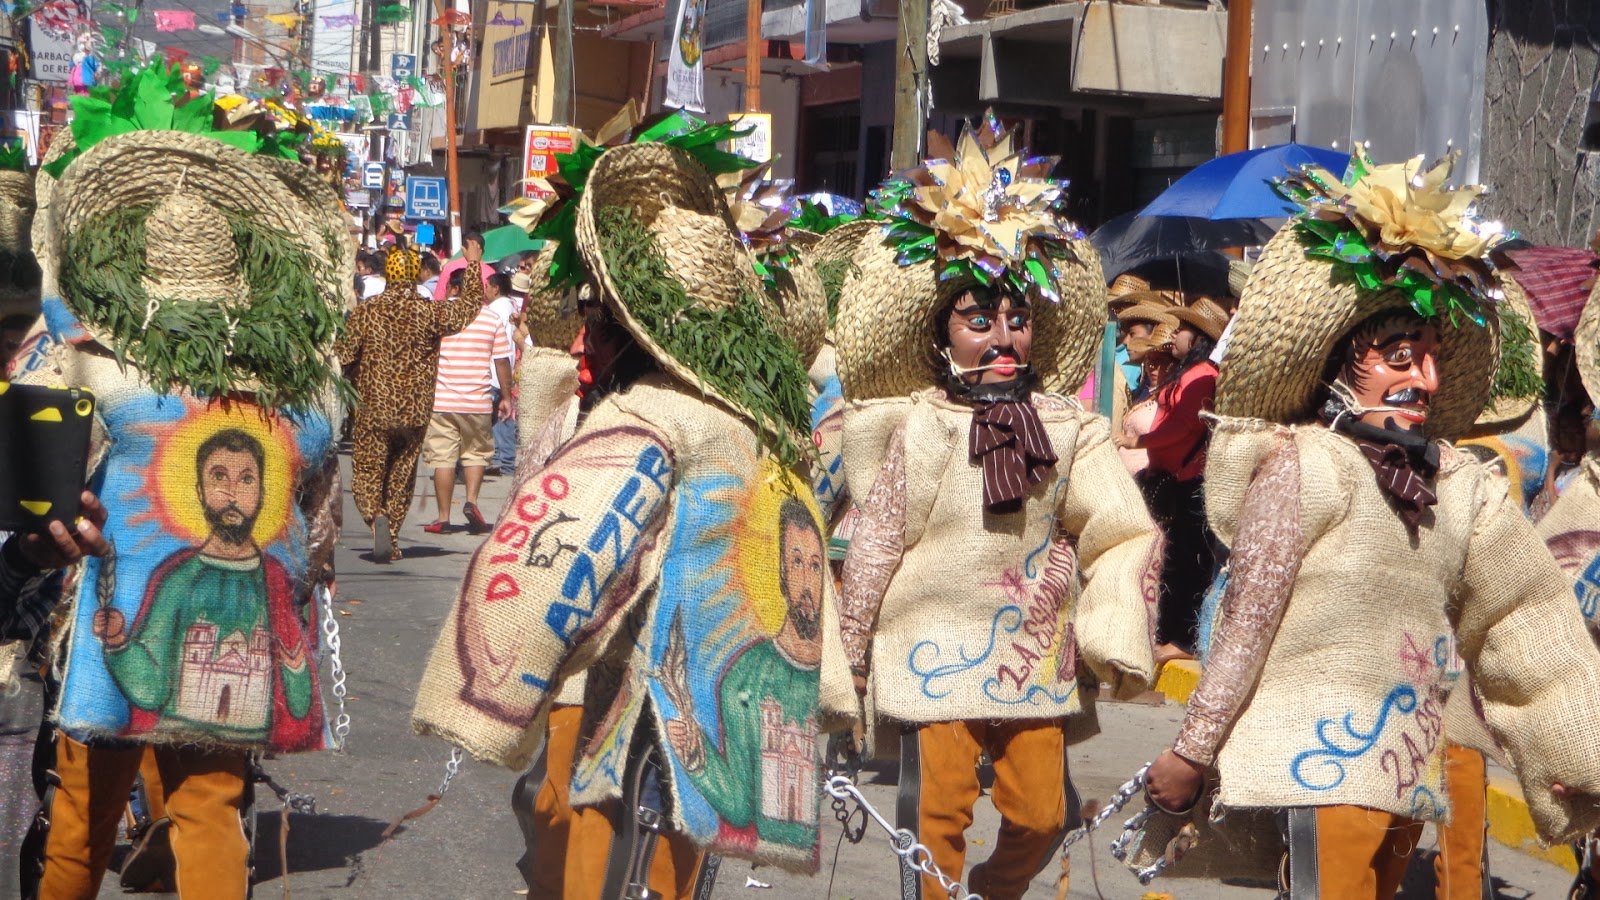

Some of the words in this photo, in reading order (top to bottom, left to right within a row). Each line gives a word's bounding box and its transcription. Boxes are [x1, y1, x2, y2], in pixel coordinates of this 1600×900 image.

[32, 51, 72, 62] BARBAC
[42, 64, 55, 73] DE
[486, 473, 569, 602] DISCO
